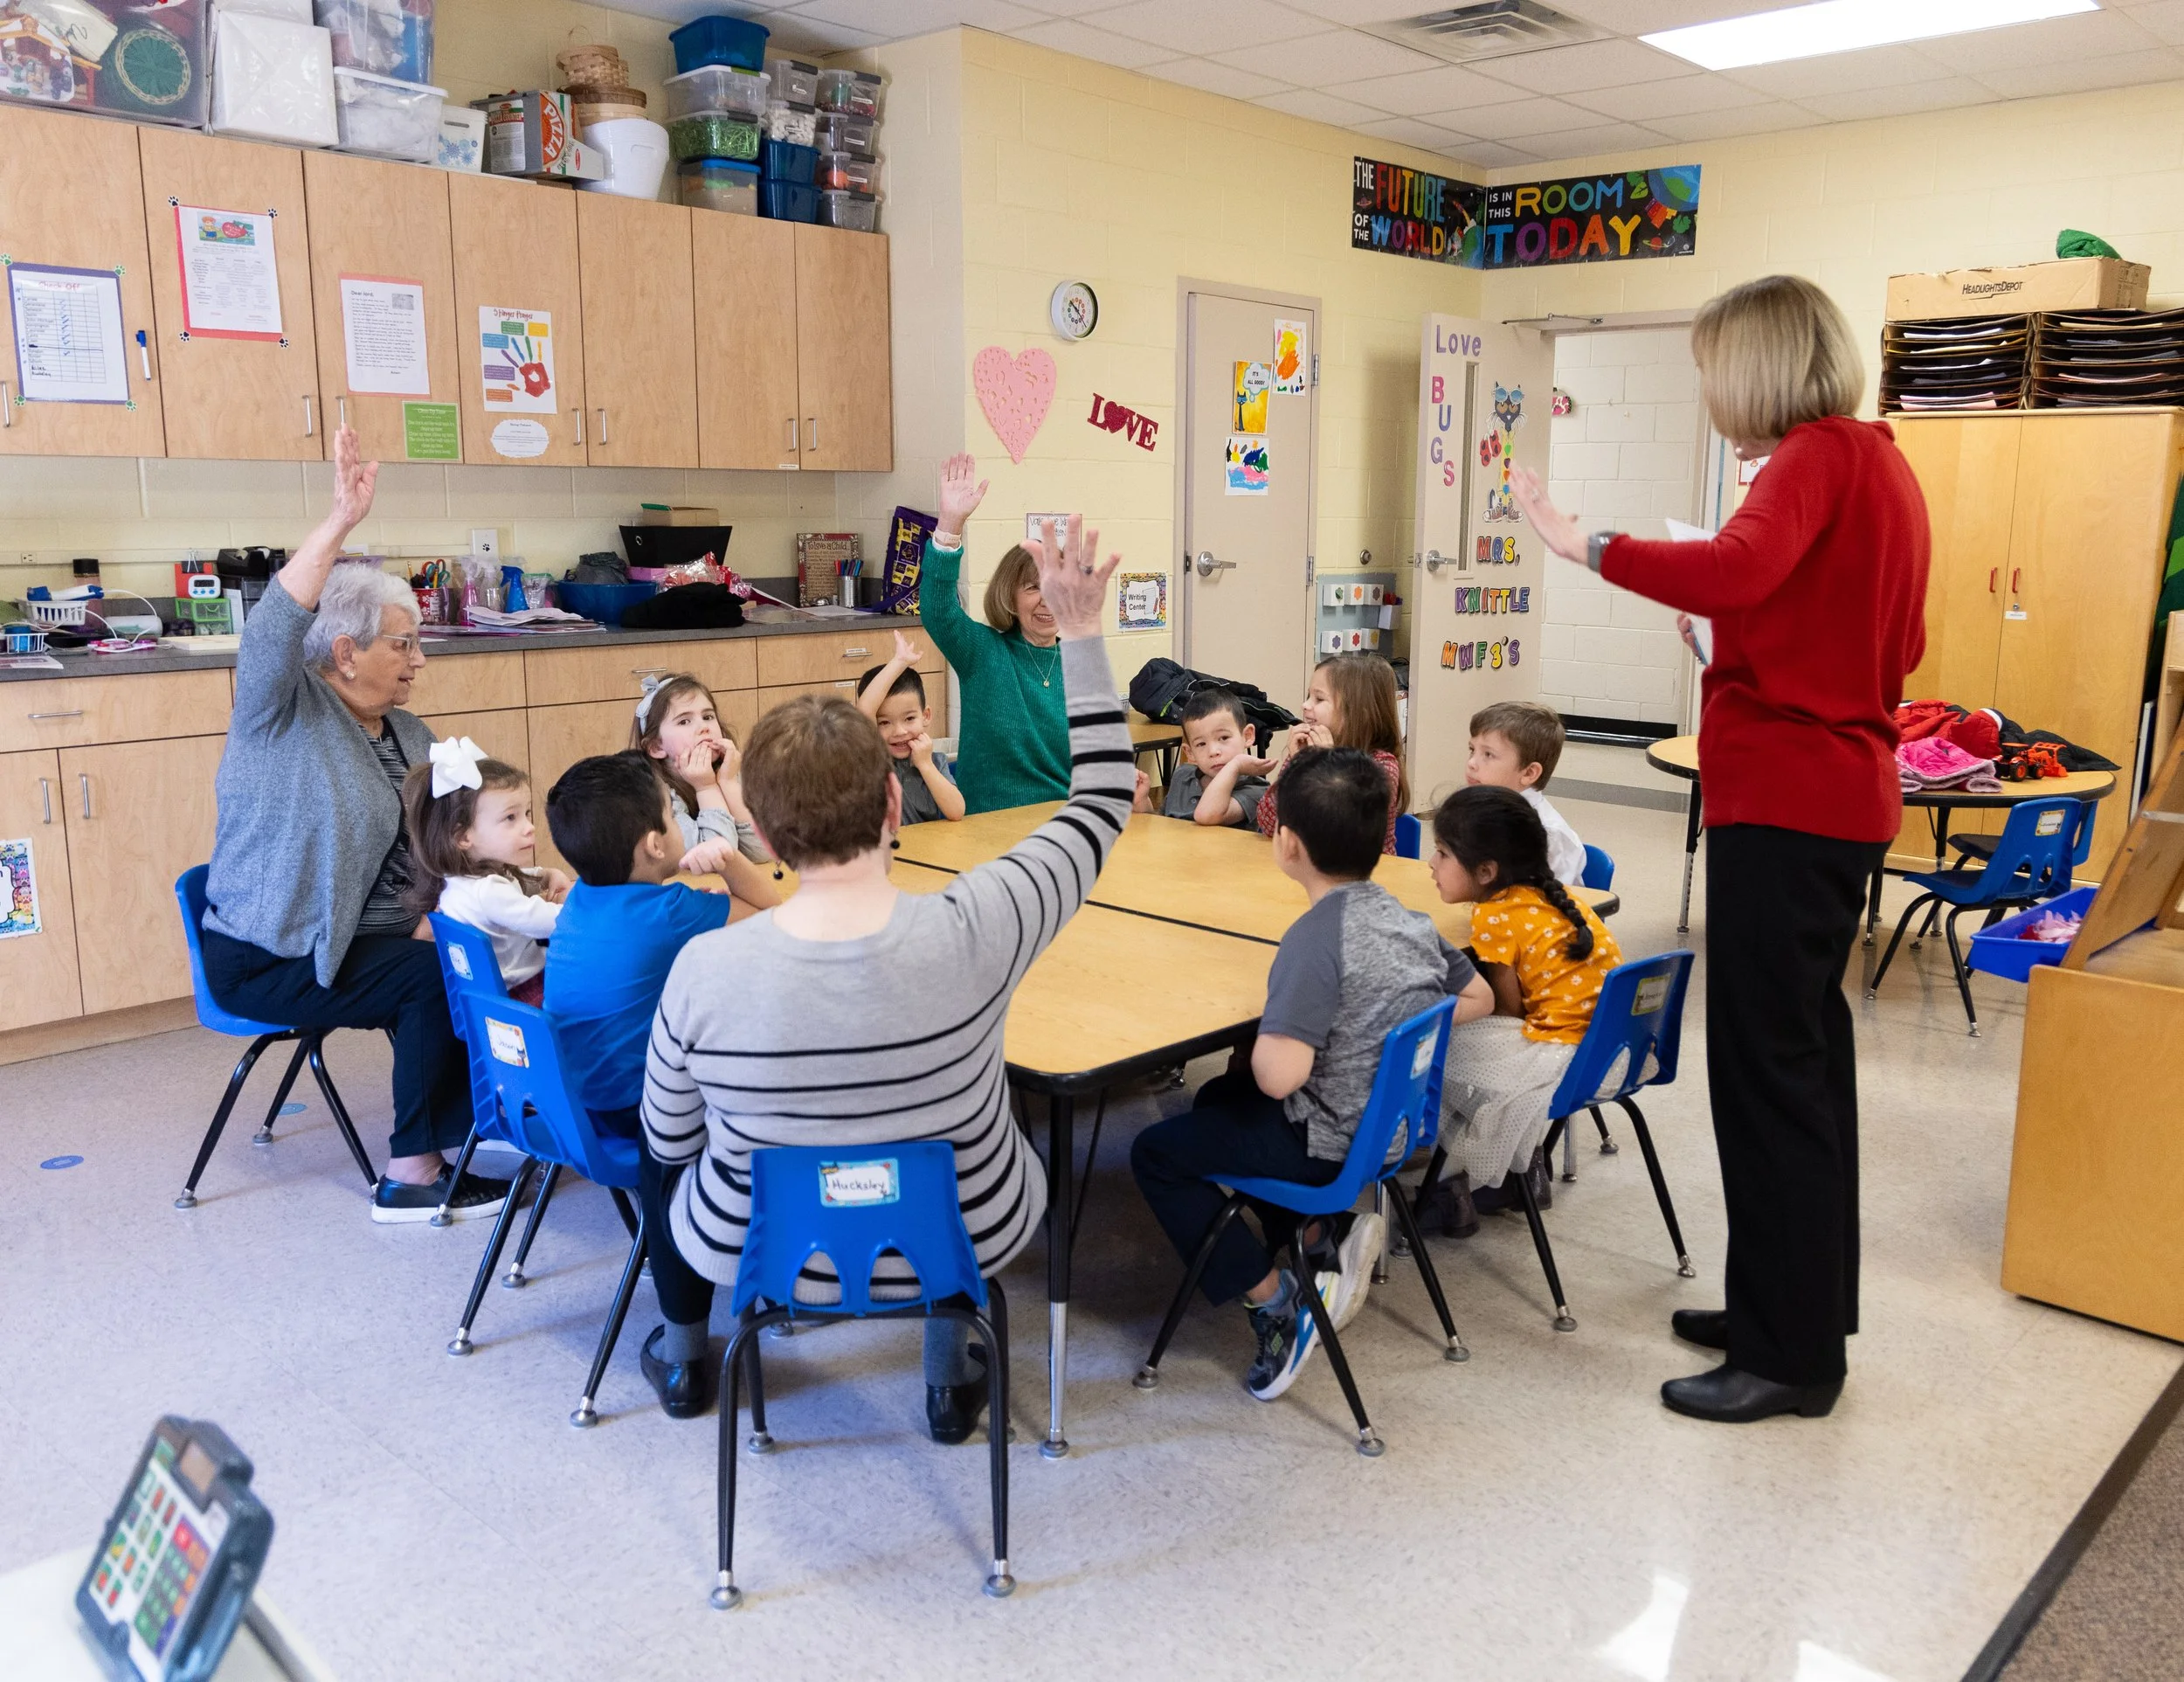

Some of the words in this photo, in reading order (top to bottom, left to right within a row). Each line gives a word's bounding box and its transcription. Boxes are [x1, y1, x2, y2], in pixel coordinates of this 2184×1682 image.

[544, 103, 564, 158] PIZZA
[1355, 161, 1374, 190] THE
[1376, 163, 1447, 223] FUTURE
[1489, 193, 1499, 203] IS
[1502, 191, 1512, 202] IN
[1515, 178, 1624, 218] ROOM
[1354, 213, 1369, 226] OF
[1489, 207, 1511, 218] THIS
[1353, 228, 1369, 241] THE
[1371, 215, 1444, 255] WORLD
[1487, 214, 1641, 265] TODAY
[499, 308, 515, 321] Finger
[1436, 324, 1482, 357] Love
[1128, 593, 1147, 602] Writing
[1455, 586, 1531, 614] KNITTLE
[832, 1179, 885, 1192] Hucksley
